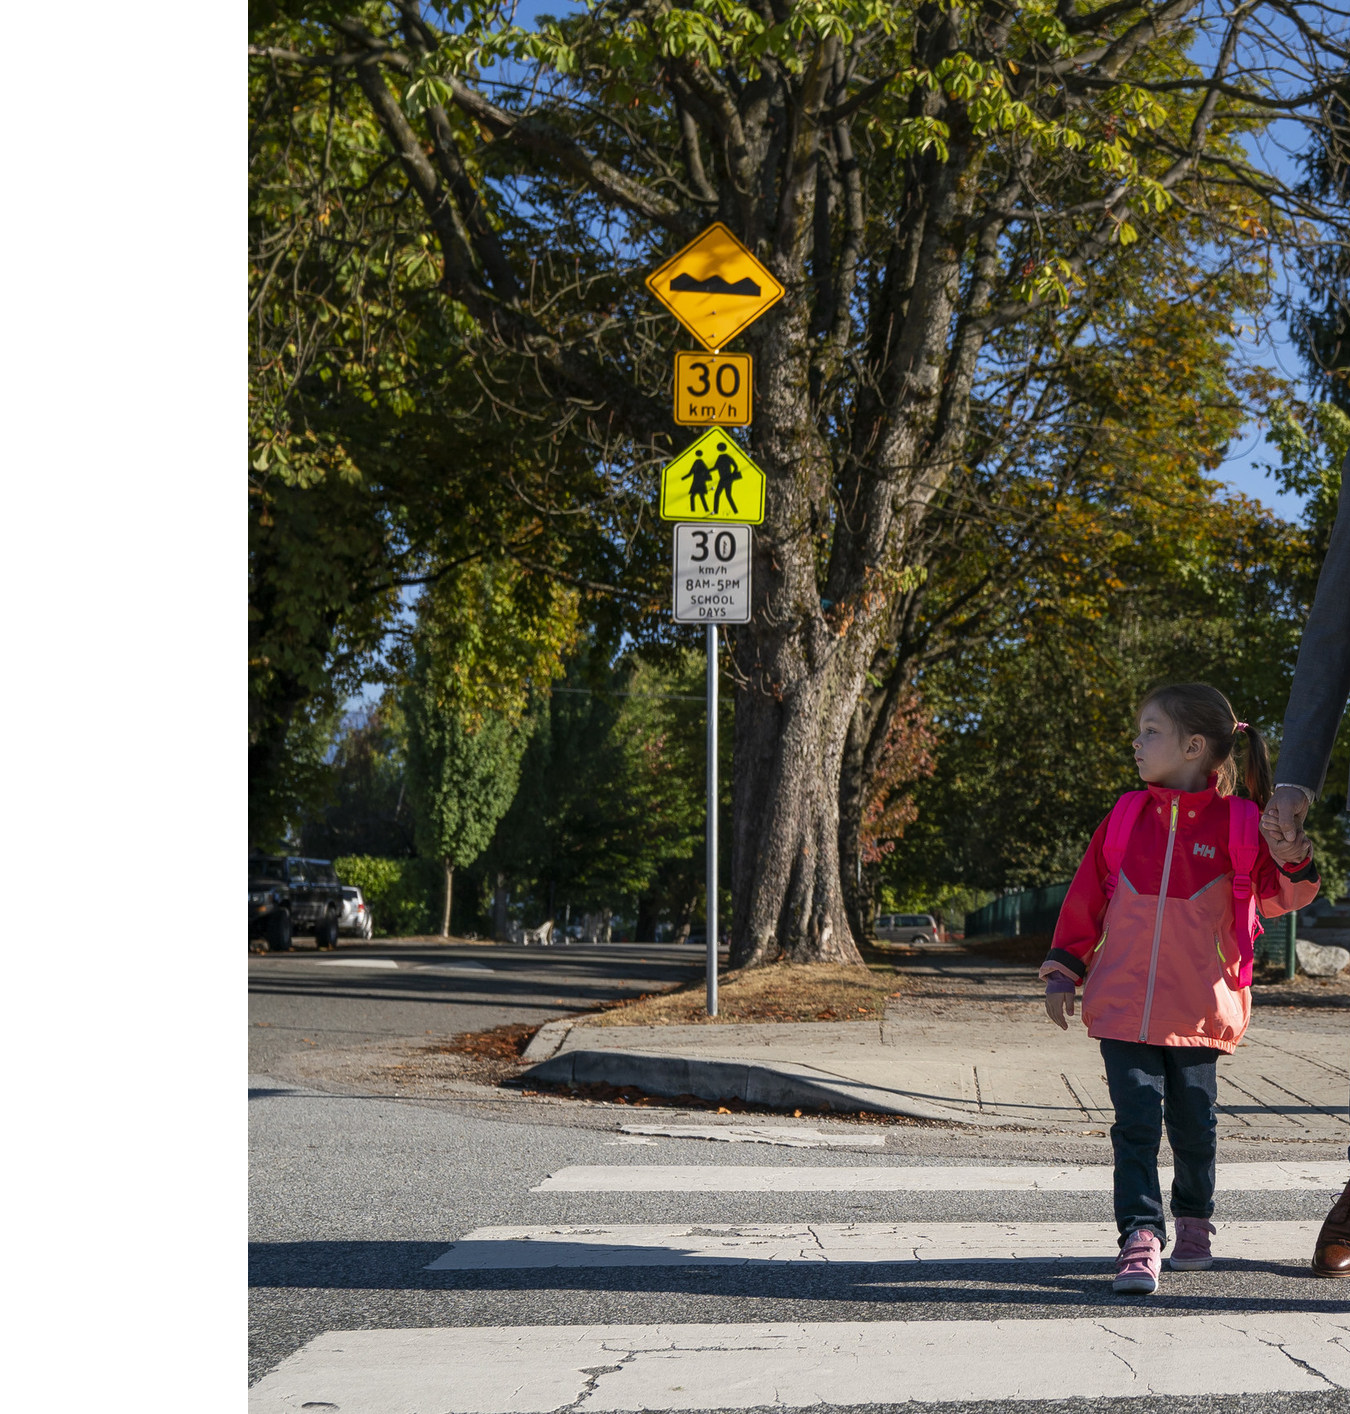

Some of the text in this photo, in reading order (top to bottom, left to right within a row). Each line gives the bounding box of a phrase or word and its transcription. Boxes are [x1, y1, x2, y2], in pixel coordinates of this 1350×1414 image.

[687, 362, 740, 398] 30
[689, 402, 737, 418] km/h
[690, 531, 737, 562] 30
[698, 565, 727, 576] km/h
[686, 579, 740, 592] 8AM-5PM
[690, 595, 735, 605] SCHOOL
[698, 607, 727, 618] DAYS
[1193, 842, 1216, 859] HH
